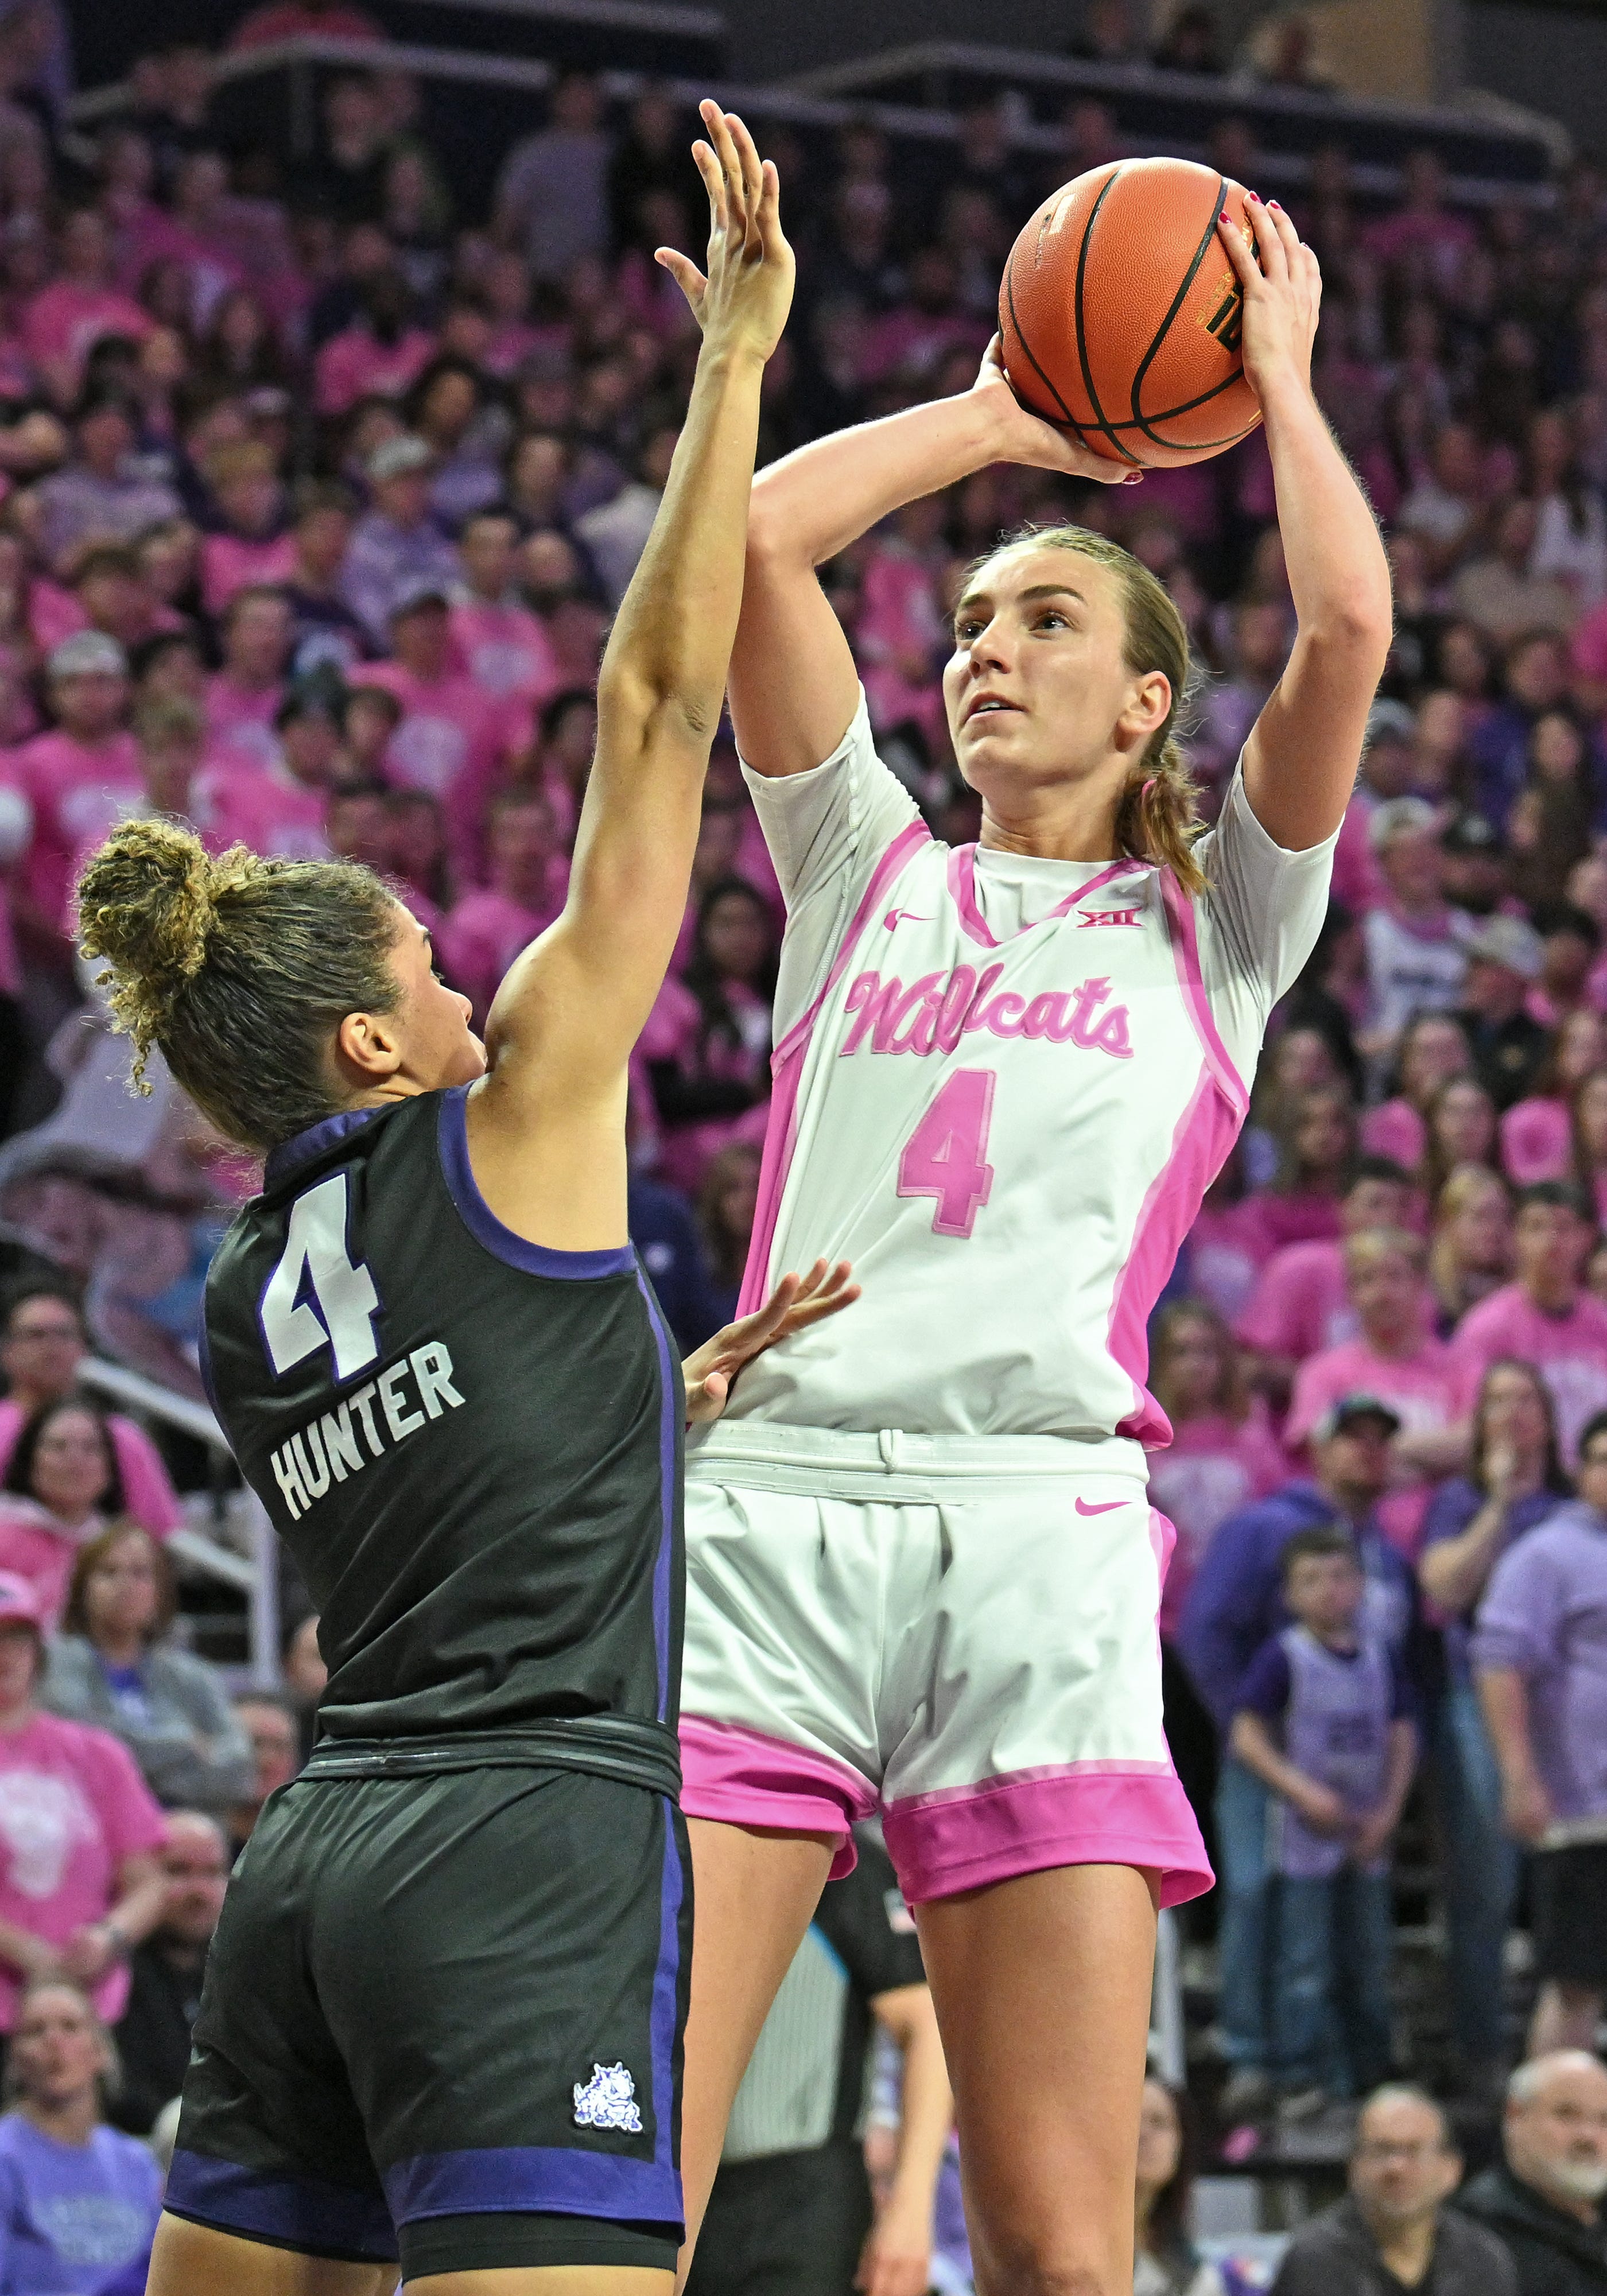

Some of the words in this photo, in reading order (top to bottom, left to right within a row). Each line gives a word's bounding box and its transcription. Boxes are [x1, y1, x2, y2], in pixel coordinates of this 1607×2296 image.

[896, 1067, 997, 1239] 4
[258, 1170, 381, 1382] 4
[270, 1340, 466, 1521] HUNTER
